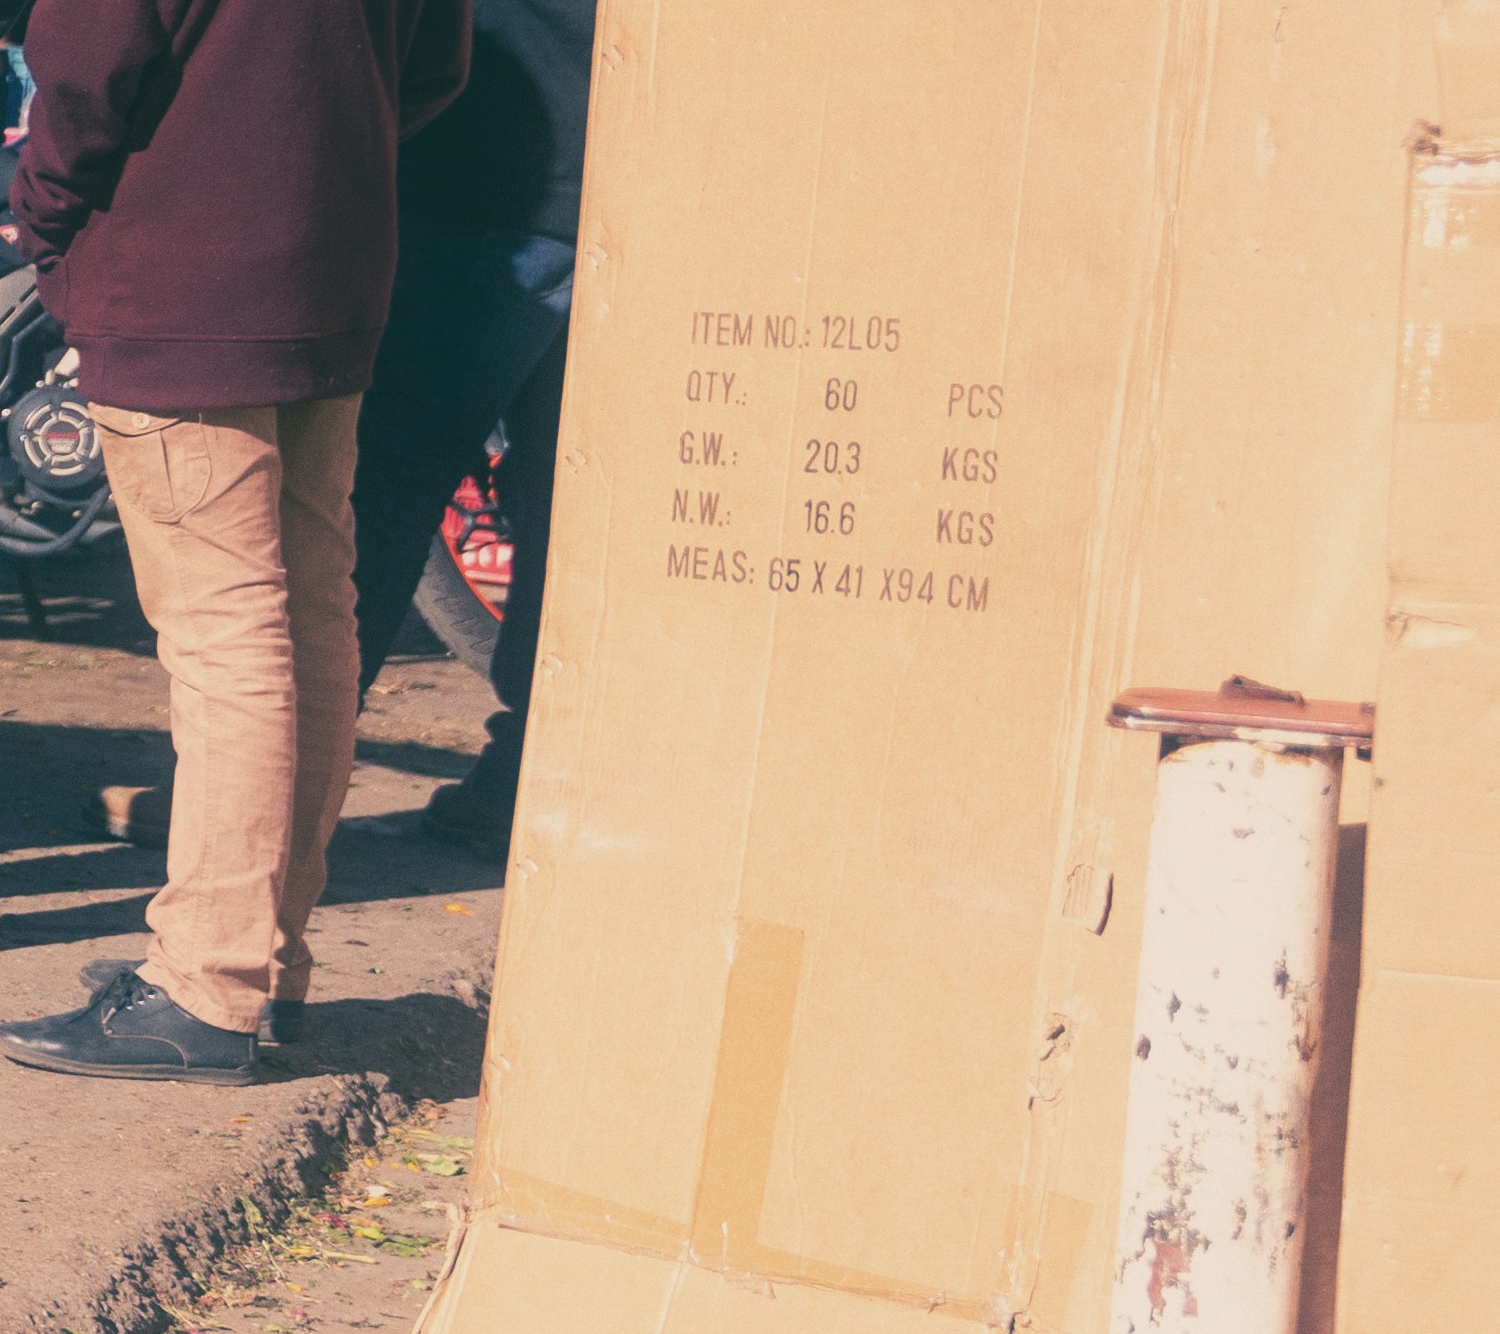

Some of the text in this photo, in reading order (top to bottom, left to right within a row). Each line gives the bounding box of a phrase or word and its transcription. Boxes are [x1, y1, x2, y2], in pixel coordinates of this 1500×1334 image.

[689, 311, 901, 353] ITEM NO.: 12L05
[685, 368, 1005, 420] QTY.: 60 PCS
[678, 430, 999, 485] G.W.: 20.3 KGS
[670, 488, 996, 549] N.W.: 16.6 KGS
[666, 544, 756, 586] MEAS:
[767, 558, 801, 594] 65
[810, 560, 827, 595] X
[833, 564, 865, 599] 41
[946, 572, 991, 613] CM
